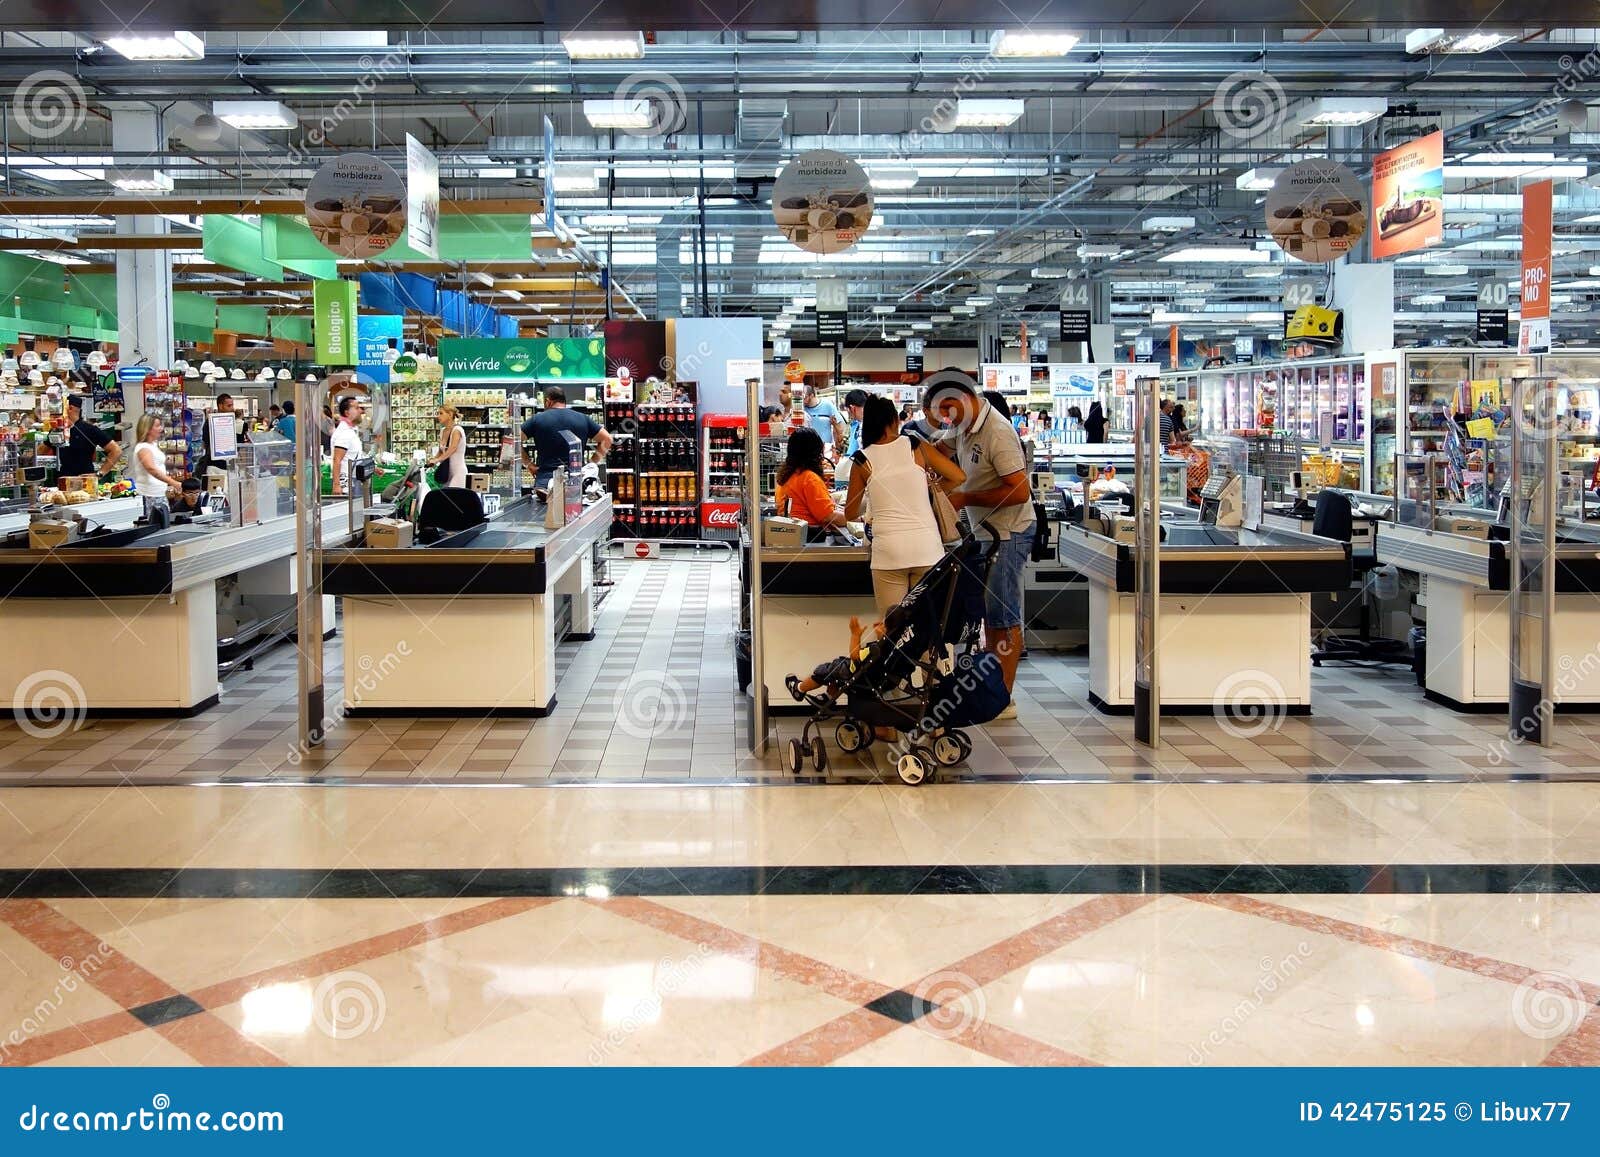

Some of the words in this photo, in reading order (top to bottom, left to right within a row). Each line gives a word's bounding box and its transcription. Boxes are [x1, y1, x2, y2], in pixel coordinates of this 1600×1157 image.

[337, 162, 350, 170] Un
[371, 163, 379, 171] di
[801, 159, 815, 167] Un
[835, 158, 843, 167] di
[333, 170, 383, 181] morbidezza
[798, 167, 847, 176] morbidezza
[1294, 167, 1308, 176] Un
[1291, 176, 1341, 185] morbidezza
[1524, 266, 1547, 285] PRO-
[1062, 284, 1088, 305] 44
[1286, 284, 1313, 305] 42
[1480, 283, 1507, 304] 40
[1524, 284, 1538, 302] MO
[328, 301, 343, 354] Biologico
[775, 342, 789, 354] 47
[907, 341, 922, 353] 45
[1031, 339, 1047, 352] 43
[1137, 339, 1151, 351] 41
[1237, 339, 1251, 351] 39
[448, 358, 468, 370] vivi
[469, 357, 500, 370] verde
